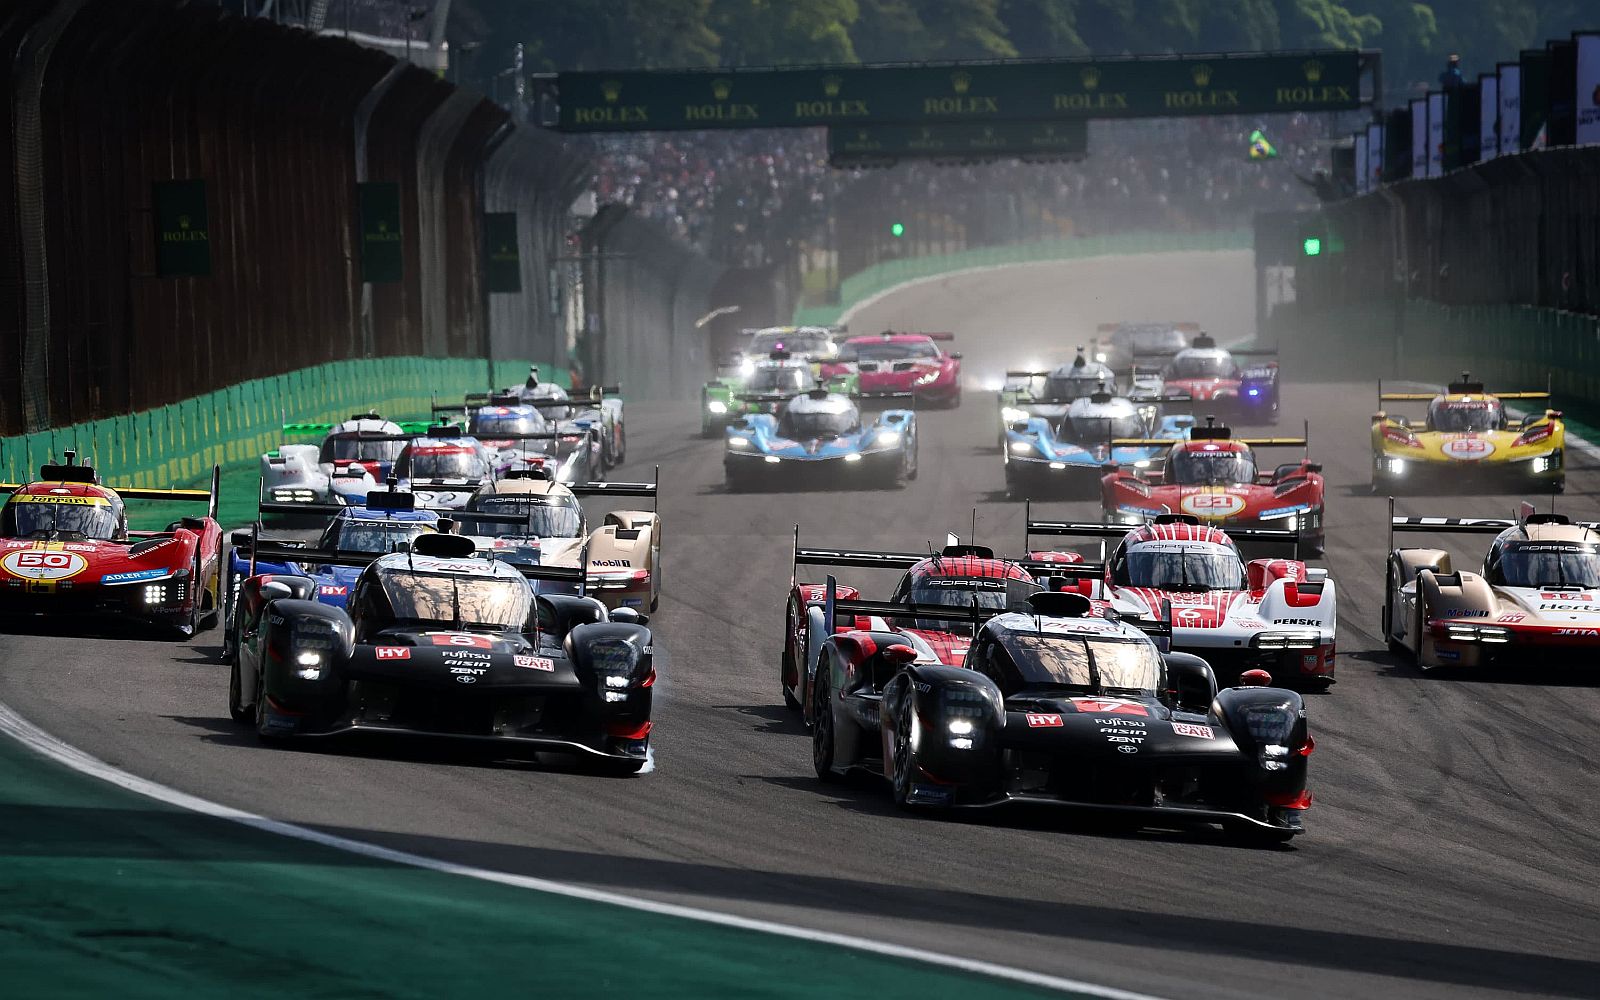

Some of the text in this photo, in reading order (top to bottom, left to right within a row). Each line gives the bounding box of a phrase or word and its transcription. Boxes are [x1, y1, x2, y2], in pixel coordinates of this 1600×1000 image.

[1165, 90, 1239, 108] ROLEX
[1276, 86, 1351, 104] ROLEX
[924, 97, 998, 114] ROLEX
[1054, 93, 1127, 110] ROLEX
[686, 104, 759, 120] ROLEX
[795, 101, 870, 117] ROLEX
[575, 106, 649, 123] ROLEX
[163, 230, 208, 242] ROLEX
[31, 495, 88, 504] Ferrari
[1195, 497, 1230, 506] 51
[344, 522, 423, 531] CADILLA
[128, 545, 159, 560] RICHARD
[20, 554, 70, 567] 50
[416, 561, 490, 571] DENSO
[105, 571, 142, 582] ADLER
[928, 580, 1008, 588] PORSCH
[321, 586, 346, 595] HY
[1178, 608, 1201, 619] 6
[1447, 608, 1477, 617] Mobil
[1043, 621, 1119, 632] DENSO
[1273, 618, 1322, 627] PENSKE
[1552, 628, 1599, 636] JOTA
[450, 635, 476, 646] 8
[378, 648, 409, 658] HY
[442, 650, 491, 660] FUJITSU
[444, 659, 491, 668] AISIN
[518, 659, 550, 669] CAR
[450, 667, 487, 675] ZENT
[1095, 701, 1122, 712] 7
[1029, 715, 1058, 726] HY
[1094, 717, 1146, 727] FUJITSU
[1100, 727, 1148, 736] AISIN
[1177, 727, 1211, 738] CAR
[1106, 735, 1145, 744] ZENT
